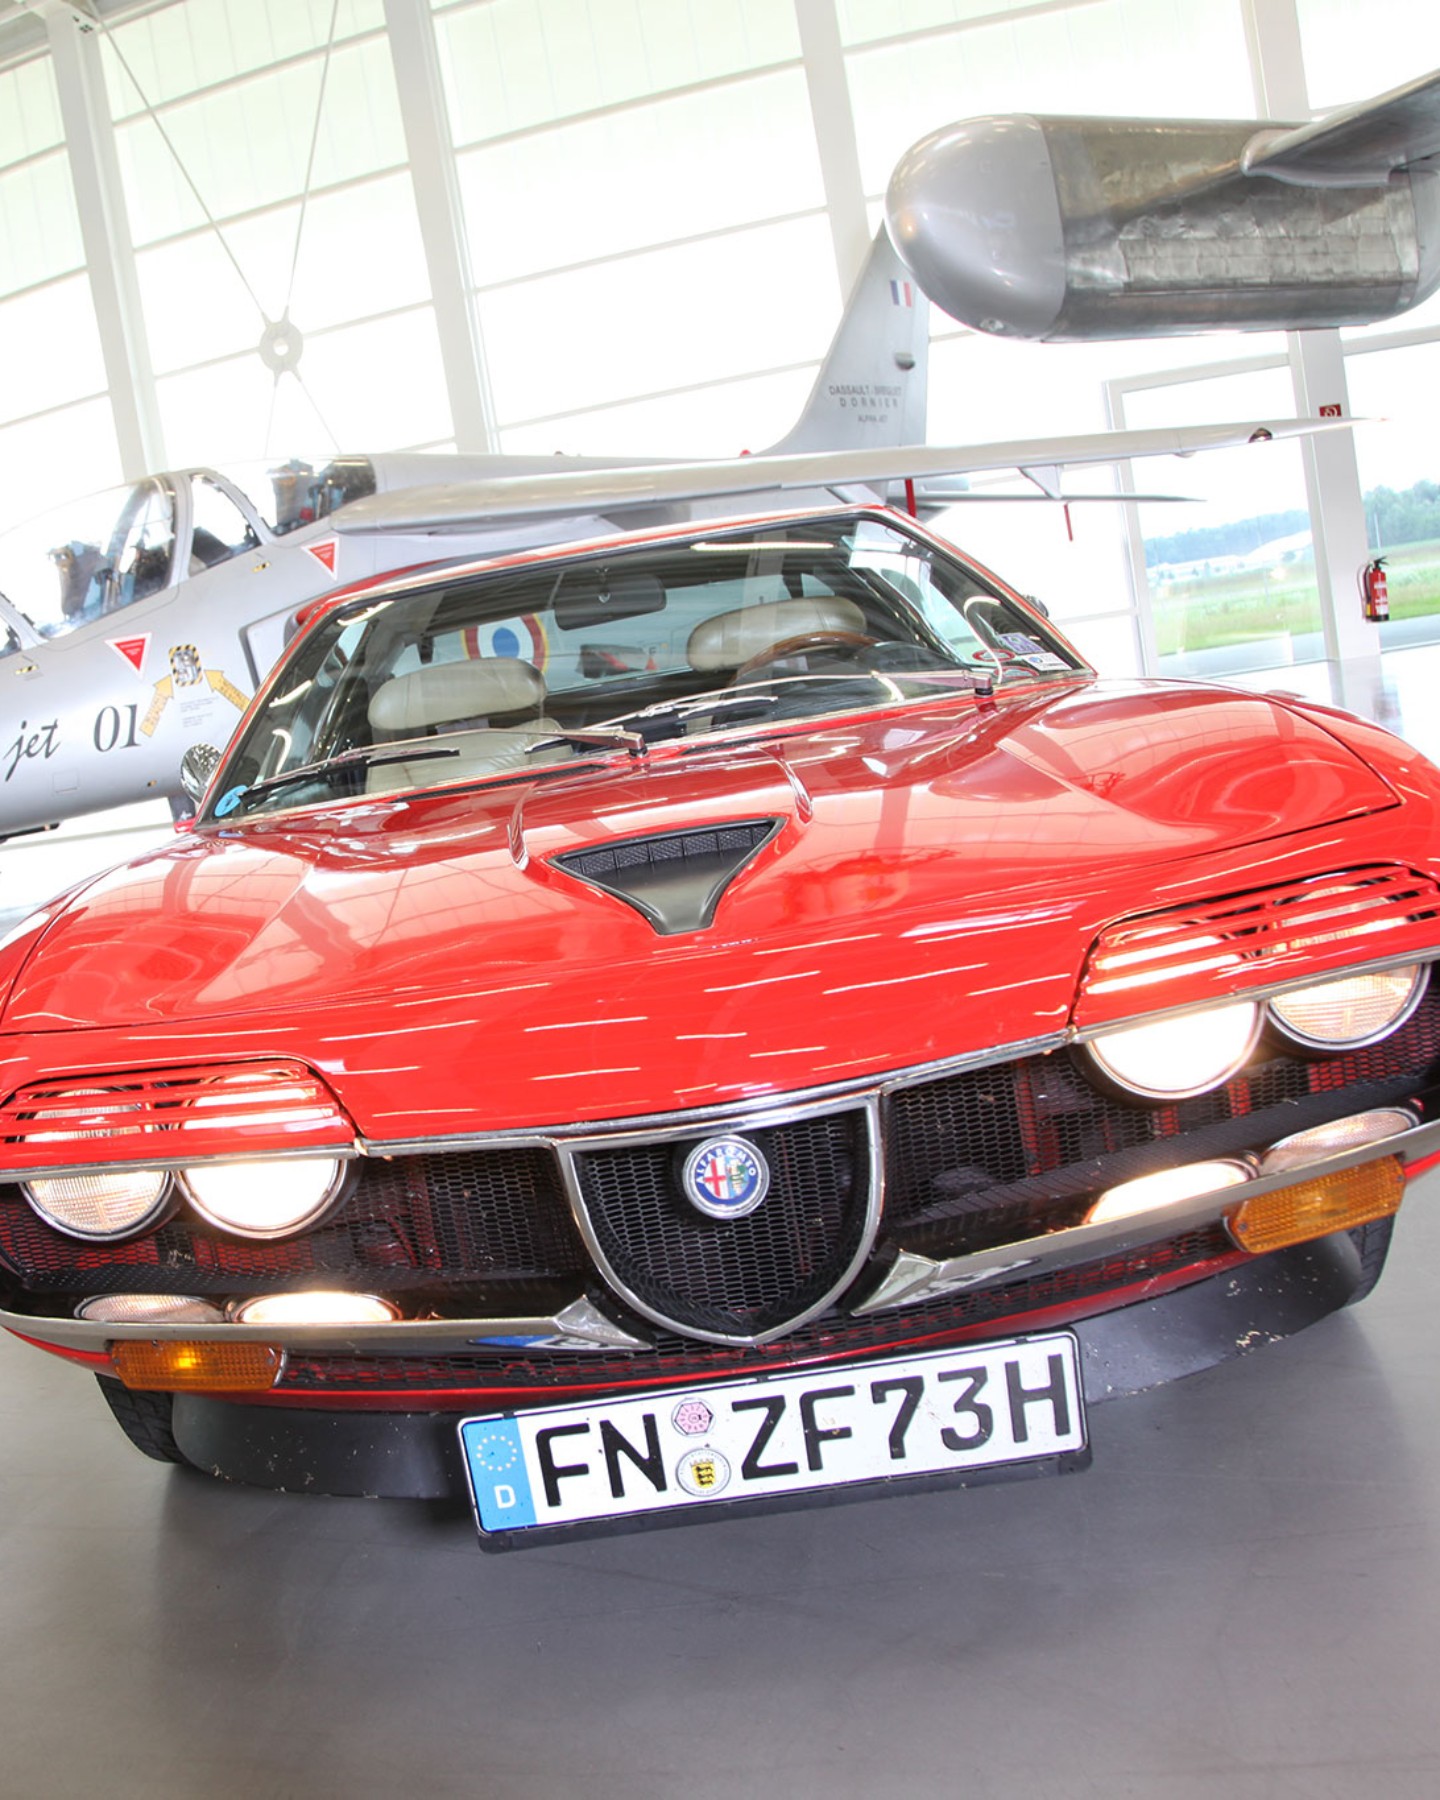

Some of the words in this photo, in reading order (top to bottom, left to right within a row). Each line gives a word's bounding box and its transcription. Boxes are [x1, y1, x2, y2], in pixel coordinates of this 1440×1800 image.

[828, 385, 870, 396] DASSAULT
[839, 397, 898, 408] DORNIER
[3, 719, 60, 782] jet
[93, 704, 141, 752] 01
[696, 1152, 716, 1184] ALFA
[715, 1146, 756, 1176] ROMEO
[535, 1413, 667, 1507] FN
[494, 1485, 517, 1509] D
